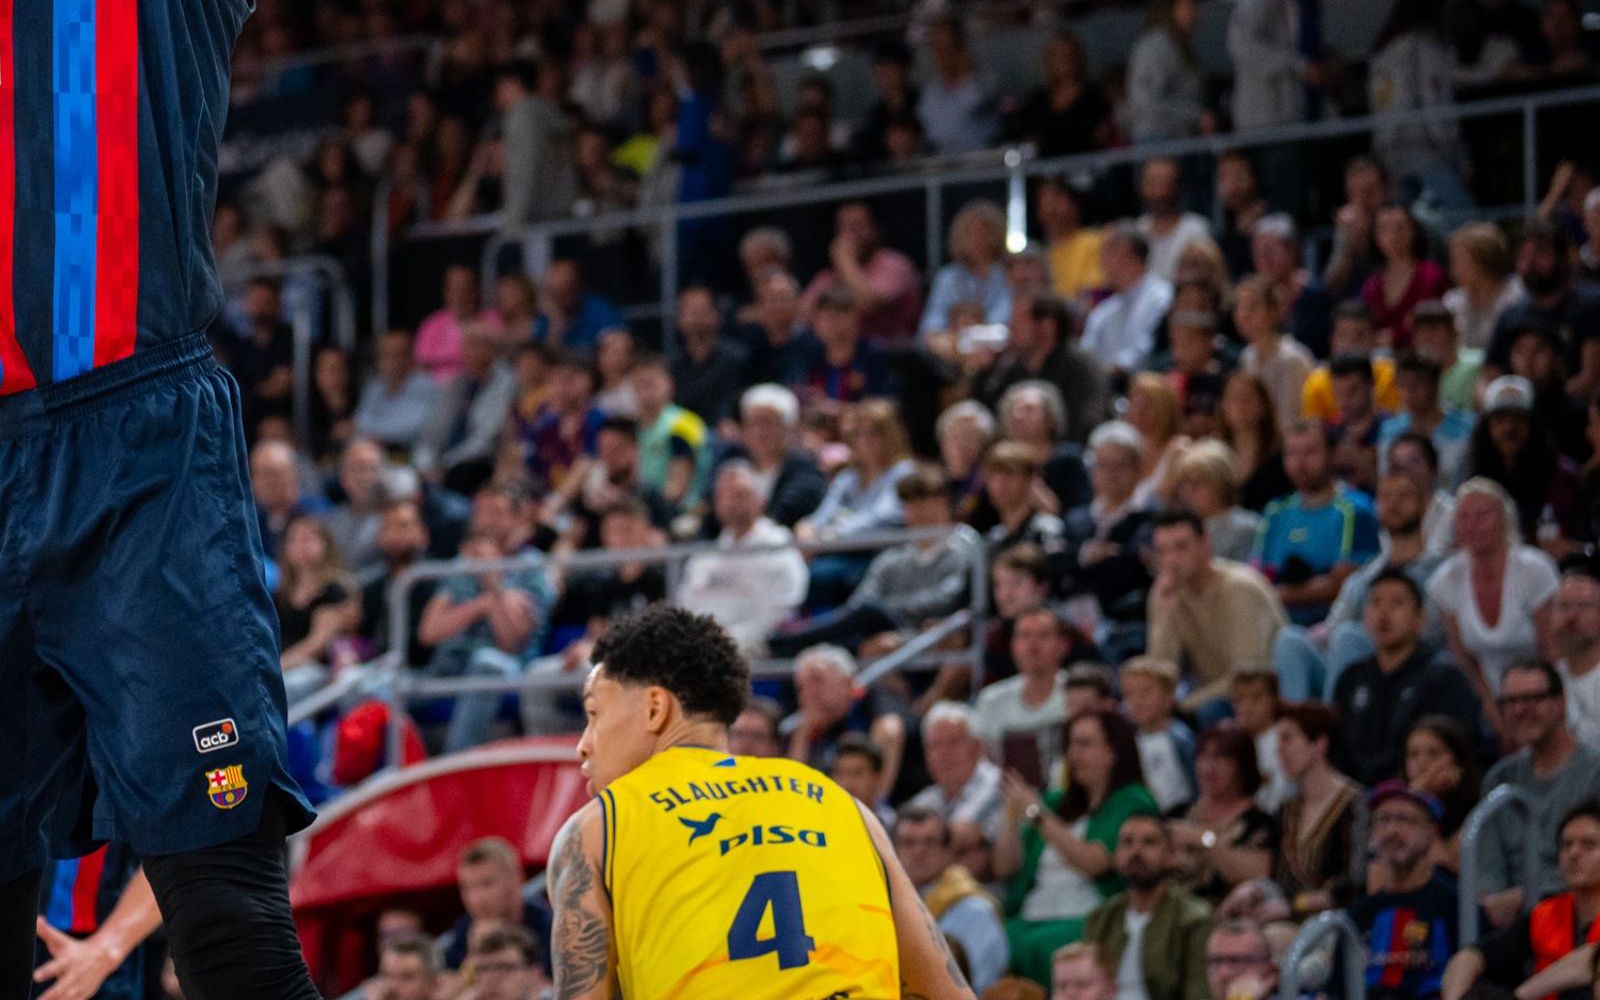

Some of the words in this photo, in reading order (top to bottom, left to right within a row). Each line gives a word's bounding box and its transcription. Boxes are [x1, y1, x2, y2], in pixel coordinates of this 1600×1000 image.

[200, 732, 229, 748] acb
[649, 774, 825, 813] SLAUGHTER
[726, 870, 817, 971] 4
